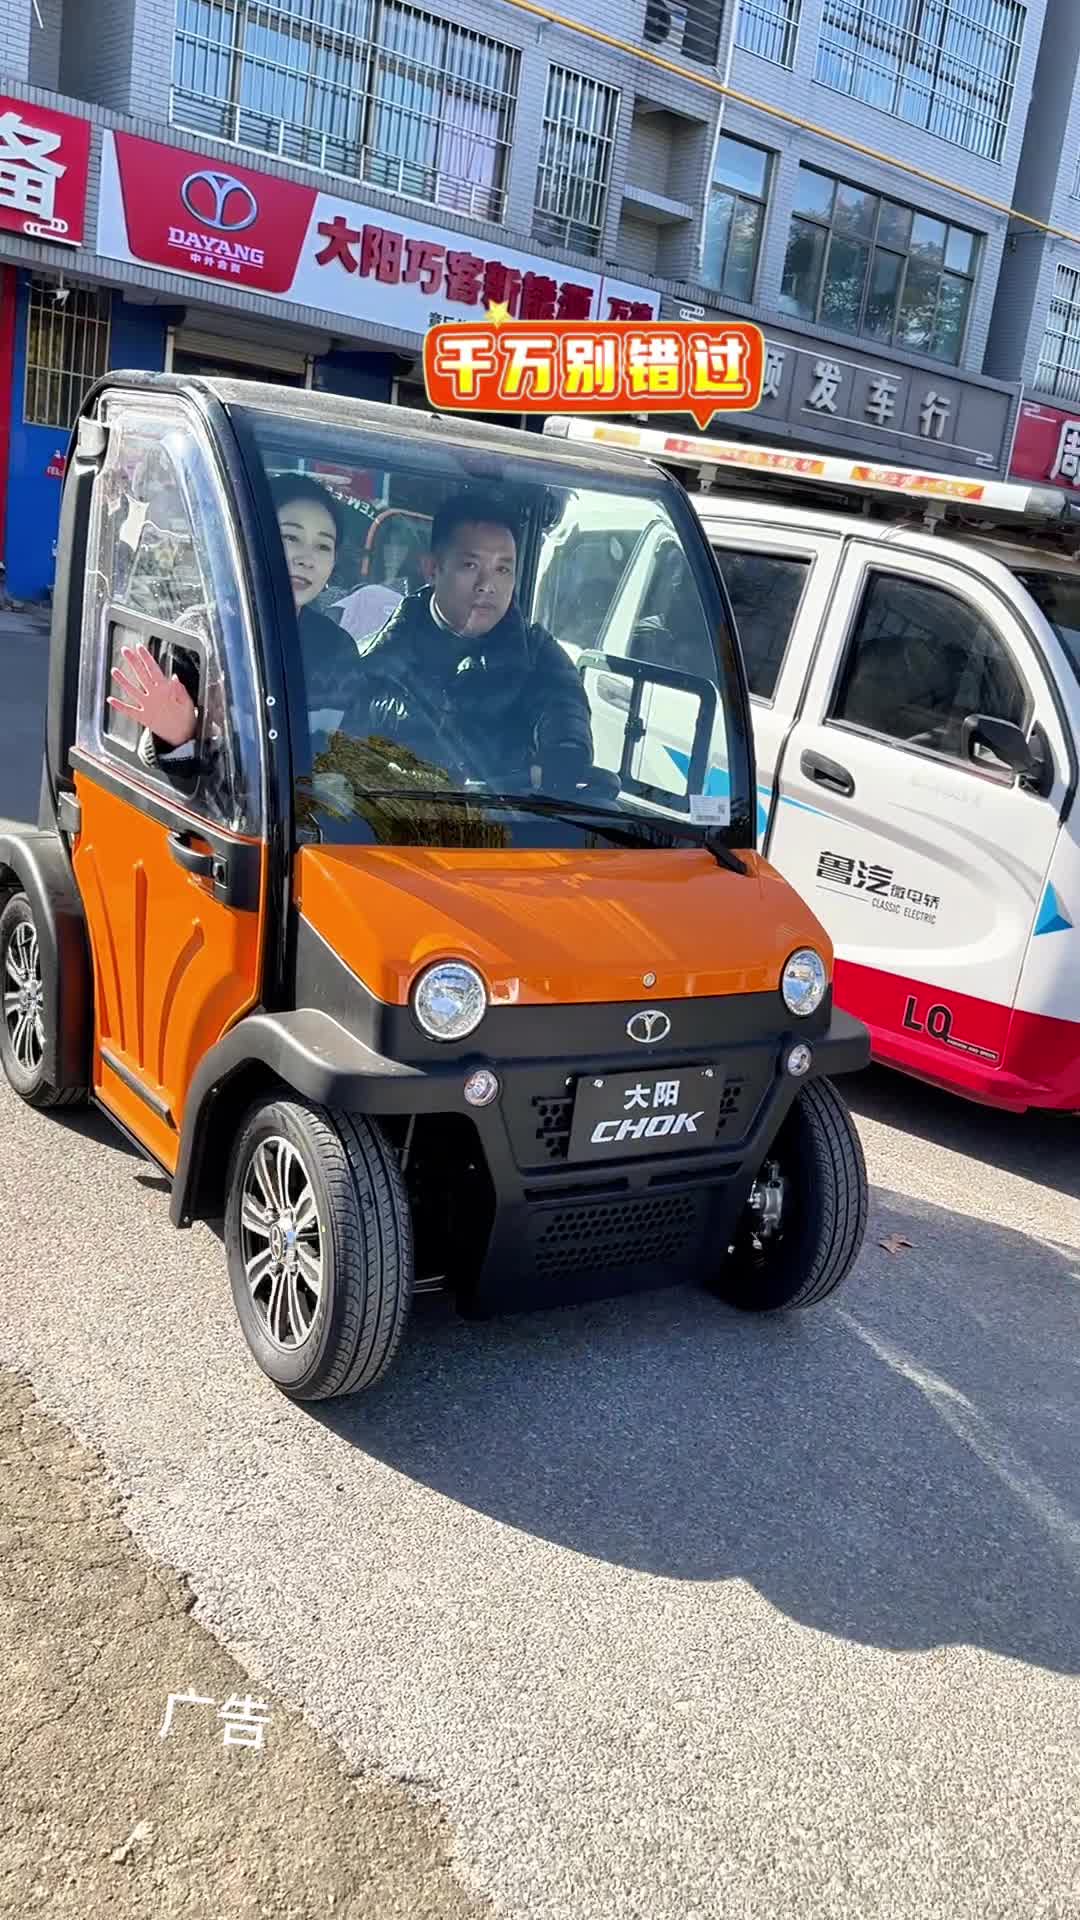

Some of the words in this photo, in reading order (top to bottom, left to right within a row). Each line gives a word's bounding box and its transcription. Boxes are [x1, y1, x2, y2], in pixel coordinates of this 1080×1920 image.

[168, 226, 264, 264] DAYANG
[903, 996, 952, 1041] LQ
[623, 1080, 680, 1110] 大阳
[590, 1111, 705, 1143] CHOK
